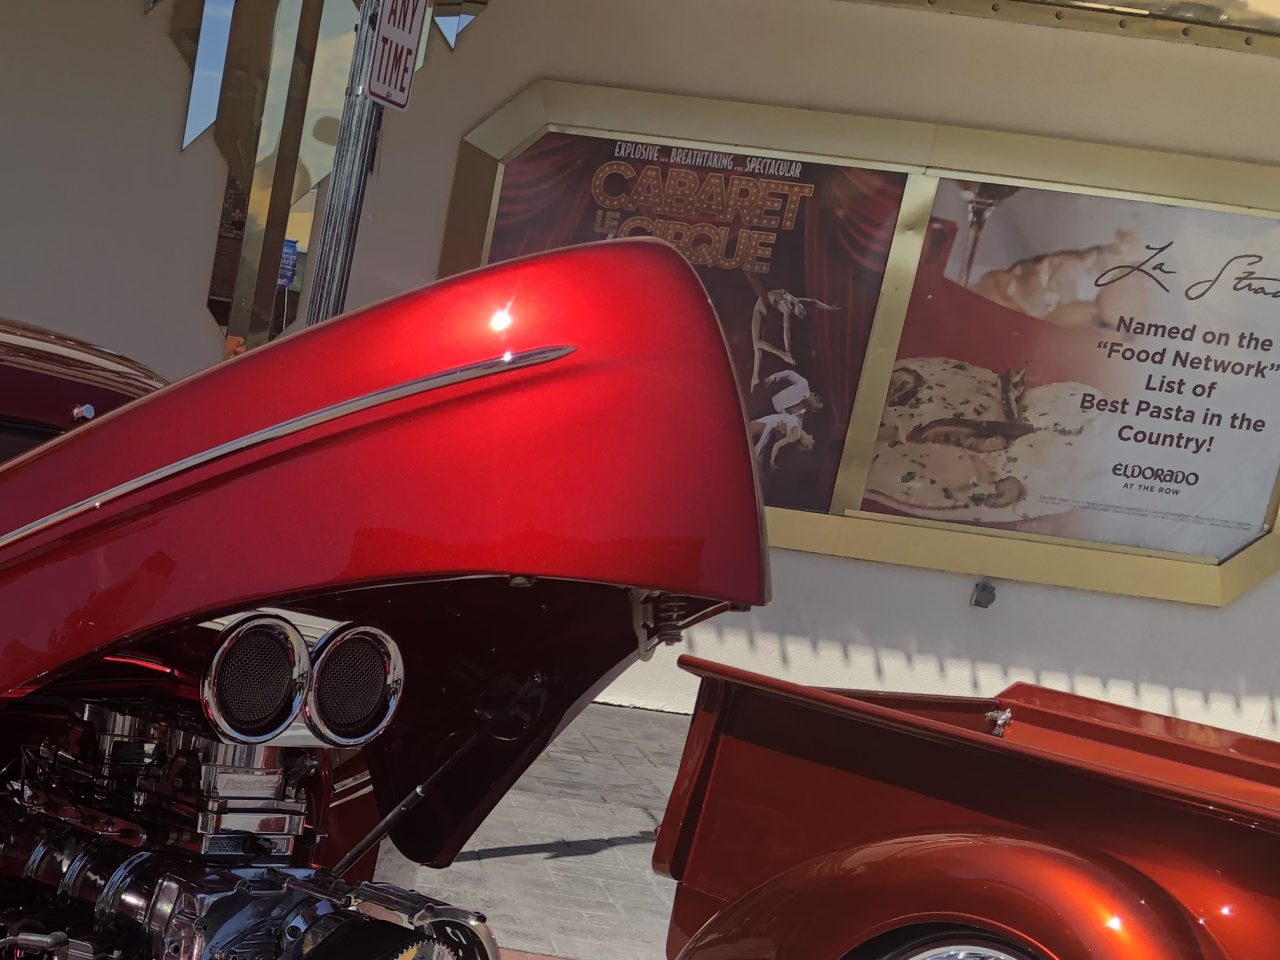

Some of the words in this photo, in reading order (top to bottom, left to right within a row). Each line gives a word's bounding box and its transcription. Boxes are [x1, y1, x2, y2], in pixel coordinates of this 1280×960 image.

[388, 0, 419, 35] ANY
[377, 36, 413, 93] TIME
[745, 157, 802, 178] SPECTACULAR
[592, 160, 815, 230] CABARET
[594, 209, 620, 233] LE
[1094, 241, 1177, 293] La
[1116, 315, 1197, 341] Named
[1202, 331, 1230, 346] on
[1237, 332, 1273, 351] the
[1145, 374, 1186, 395] List
[1192, 381, 1218, 398] of
[1080, 393, 1129, 414] Best
[1135, 400, 1195, 423] Pasta
[1202, 408, 1223, 426] in
[1230, 412, 1266, 432] the
[1117, 425, 1215, 454] Country!
[1122, 482, 1134, 490] AT
[1138, 484, 1156, 493] THE
[1158, 487, 1181, 496] ROW
